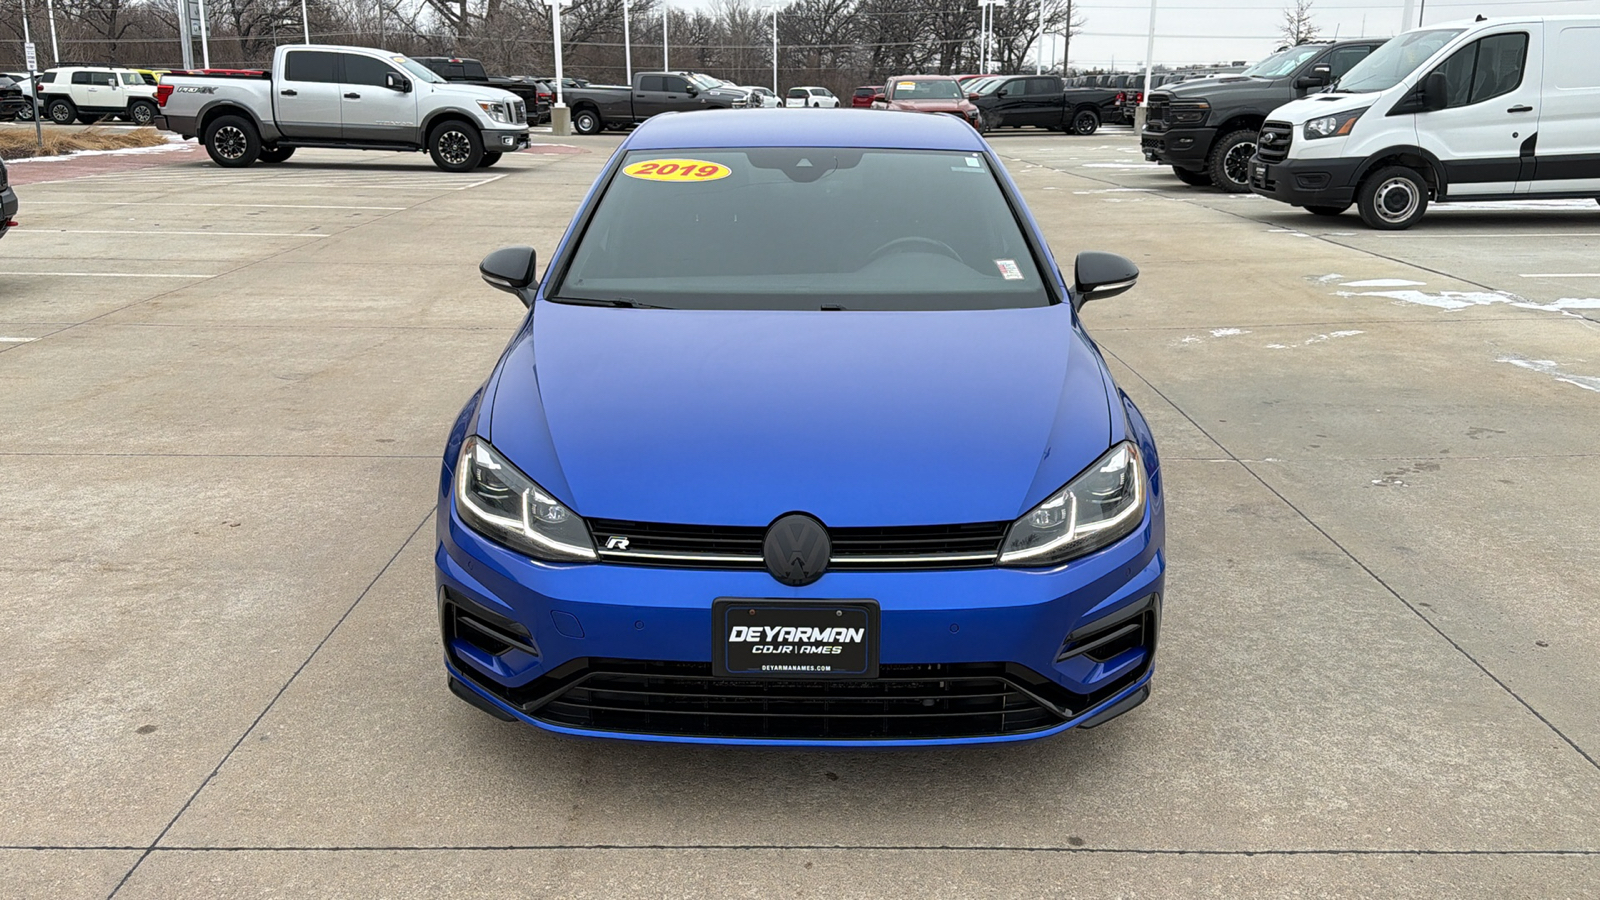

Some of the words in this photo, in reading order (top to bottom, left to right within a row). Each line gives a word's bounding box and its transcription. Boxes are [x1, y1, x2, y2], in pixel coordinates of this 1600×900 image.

[633, 163, 719, 177] 2019
[605, 536, 630, 550] R
[729, 626, 865, 643] DEYARMAN
[752, 645, 791, 654] CDJR
[800, 646, 843, 655] AMES
